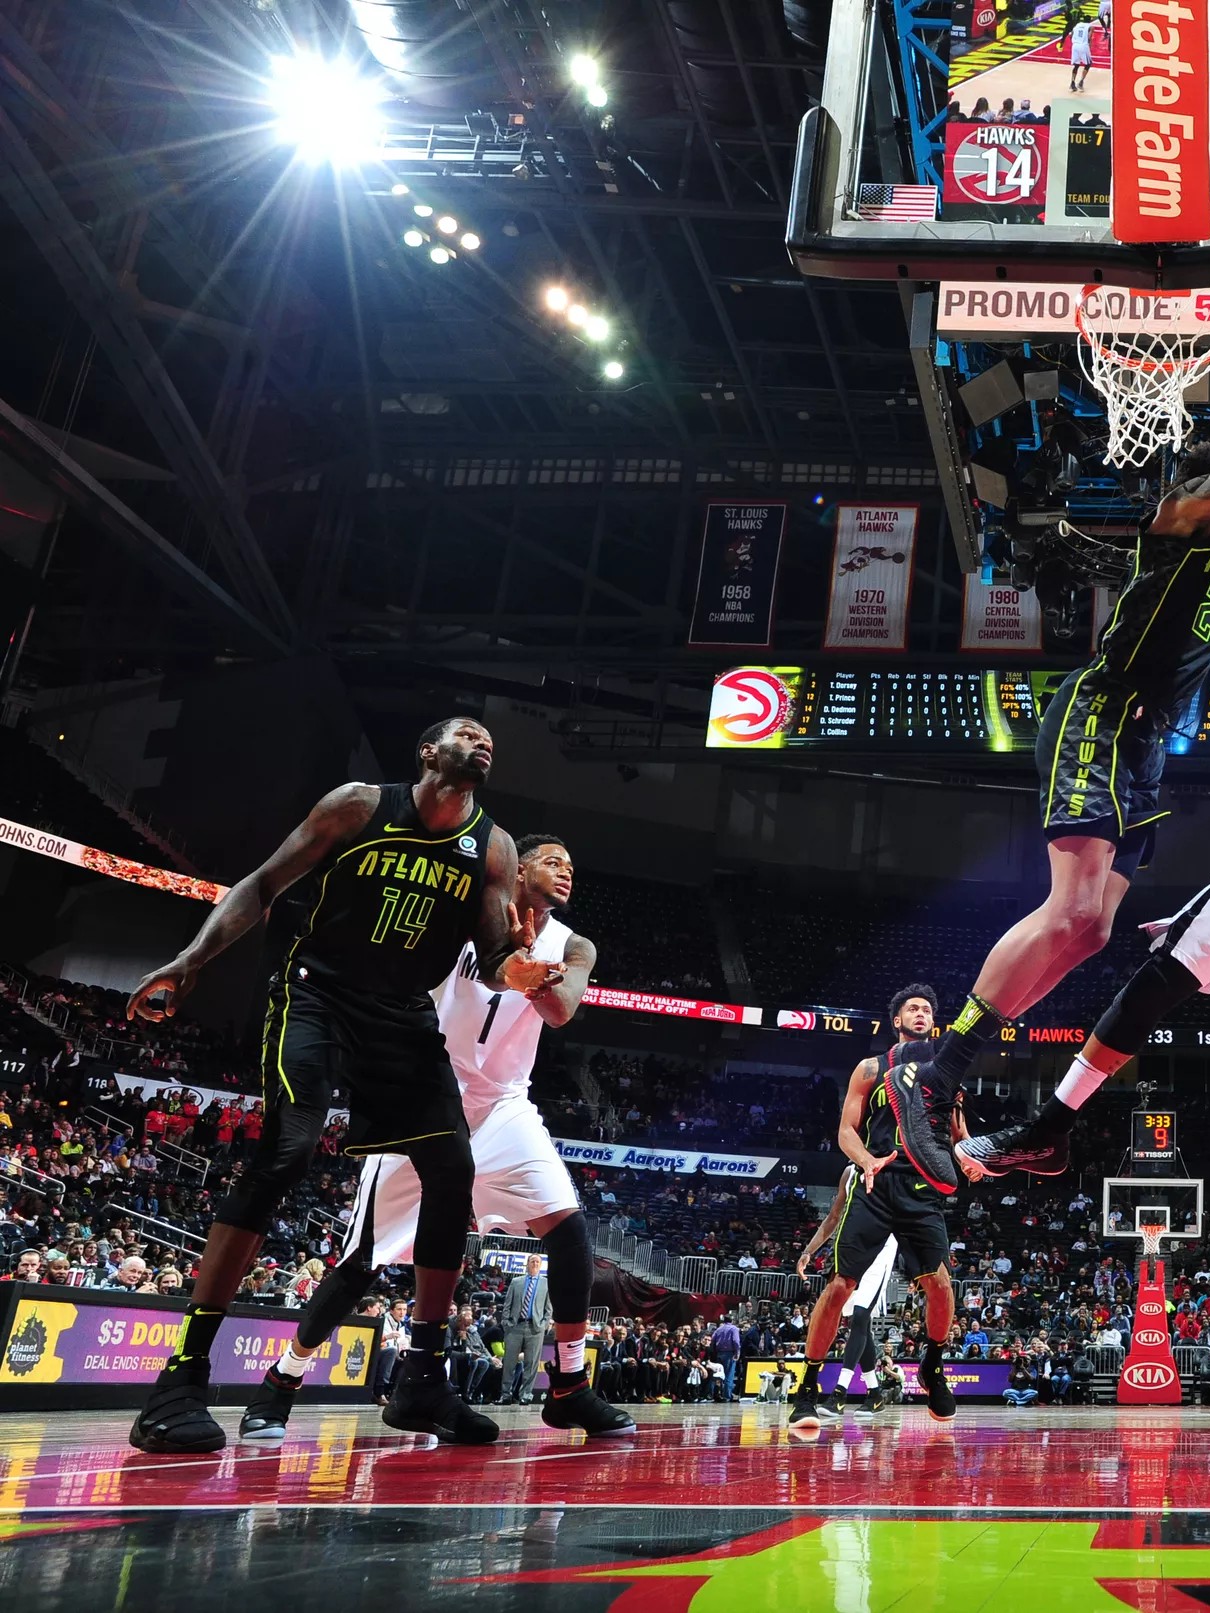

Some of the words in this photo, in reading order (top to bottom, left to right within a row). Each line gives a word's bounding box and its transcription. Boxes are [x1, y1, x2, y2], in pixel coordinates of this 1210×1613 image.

[980, 11, 994, 23] KIA
[977, 127, 1035, 145] HAWKS
[1069, 132, 1092, 144] TOL:
[1094, 130, 1104, 146] 7
[981, 148, 1035, 197] 14
[1067, 193, 1091, 203] TEAM
[944, 290, 1069, 318] PROMO
[1084, 291, 1180, 321] CODE:
[724, 508, 738, 518] ST.
[741, 508, 768, 519] LOUIS
[856, 511, 899, 521] ATLANTA
[727, 519, 763, 530] HAWKS
[858, 522, 894, 533] HAWKS
[721, 585, 751, 599] 1958
[855, 589, 885, 604] 1970
[988, 590, 1020, 605] 1980
[725, 601, 742, 611] NBA
[848, 605, 887, 615] WESTERN
[985, 607, 1021, 617] CENTRAL
[708, 612, 755, 623] CHAMPIONS
[849, 616, 884, 627] DIVISION
[985, 618, 1020, 628] DIVISION
[841, 628, 889, 639] CHAMPIONS
[978, 630, 1026, 640] CHAMPIONS
[836, 672, 855, 680] Player
[836, 682, 857, 690] Dorsey
[1015, 693, 1032, 701] 100%
[1021, 702, 1032, 710] 0%
[827, 728, 848, 736] Collins
[0, 823, 67, 858] OHNS.COM
[357, 851, 472, 901] ATLANTA
[371, 887, 435, 950] 14
[600, 989, 629, 1001] SCORE
[630, 993, 641, 1002] 50
[642, 995, 653, 1004] BY
[654, 996, 697, 1009] HALFTIME
[599, 997, 634, 1008] SCORE
[636, 1001, 664, 1012] HALF
[665, 1005, 689, 1016] OFF!
[701, 1008, 716, 1017] PAPA
[477, 993, 503, 1045] 1
[823, 1015, 853, 1032] TOL
[871, 1021, 880, 1035] 7
[1000, 1027, 1016, 1042] 02
[1029, 1028, 1085, 1043] HAWKS
[2, 1060, 26, 1074] 117
[87, 1077, 108, 1089] 118
[1145, 1115, 1171, 1128] 3:33
[1154, 1128, 1168, 1149] 9
[554, 1141, 613, 1161] Aaron's
[622, 1150, 686, 1168] Aaron's
[694, 1156, 758, 1173] Aaron's
[781, 1164, 798, 1174] 119
[1143, 1305, 1159, 1313] KIA
[97, 1319, 127, 1345] $5
[129, 1322, 181, 1347] DOW
[1140, 1333, 1160, 1342] KIA
[9, 1342, 37, 1354] planet
[233, 1335, 262, 1357] $10
[262, 1337, 275, 1357] A
[11, 1352, 40, 1363] fitness
[84, 1355, 110, 1370] DEAL
[112, 1355, 140, 1370] ENDS
[243, 1359, 257, 1370] NO
[1132, 1369, 1166, 1383] KIA
